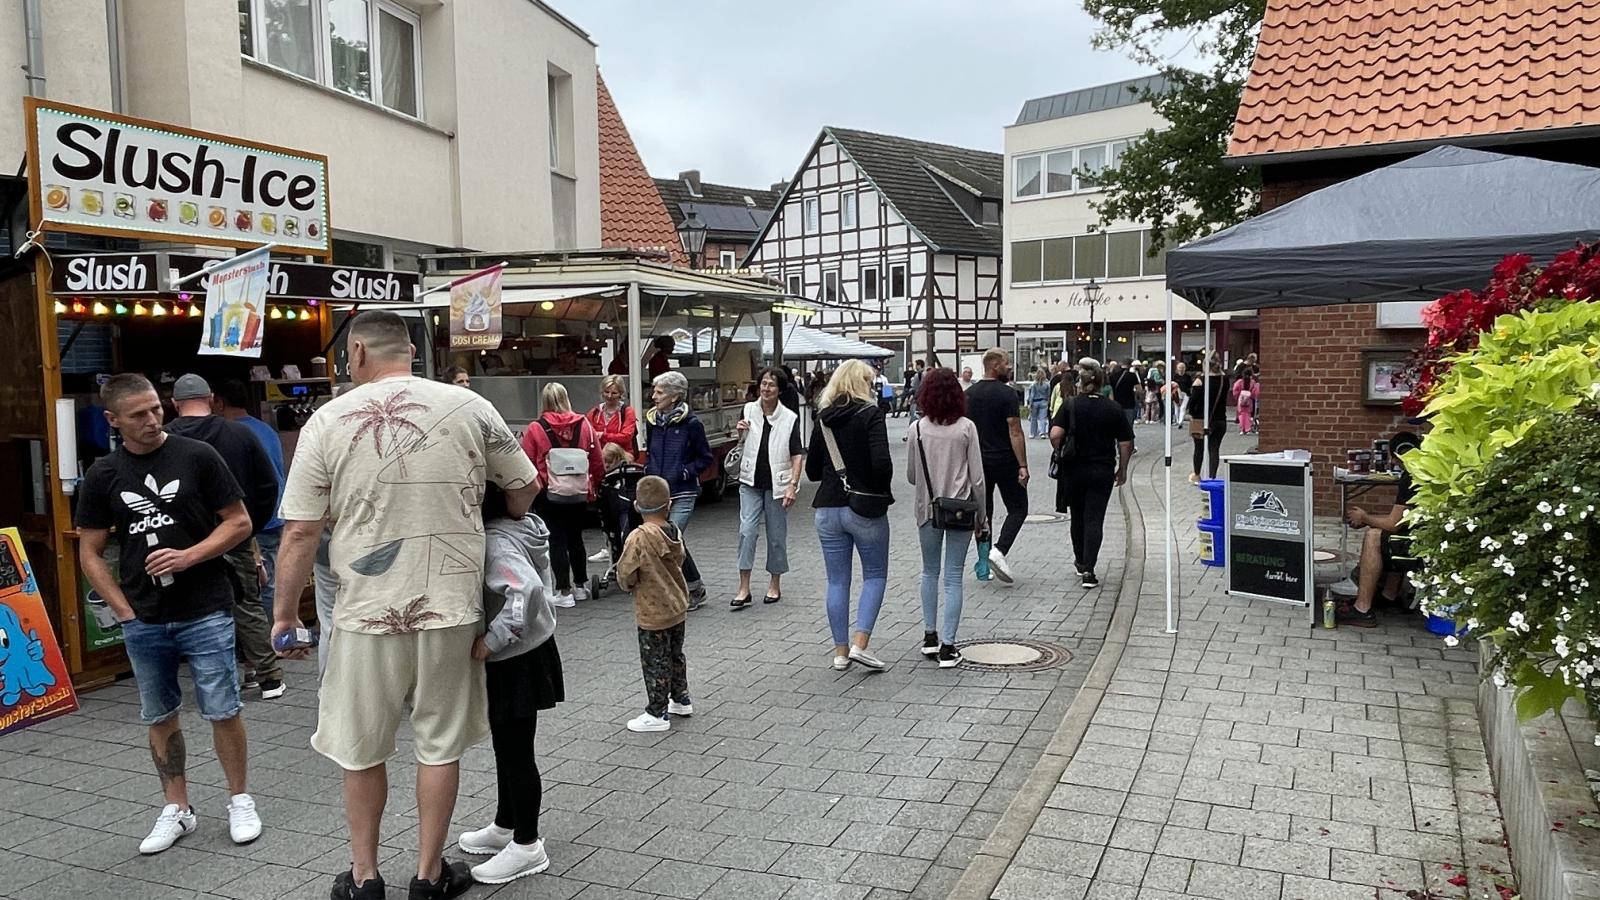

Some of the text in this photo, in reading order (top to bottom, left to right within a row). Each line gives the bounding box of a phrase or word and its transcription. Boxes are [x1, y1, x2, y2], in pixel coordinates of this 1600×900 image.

[52, 122, 316, 211] Slush-Ice
[66, 256, 147, 291] Slush
[330, 269, 400, 300] Slush
[452, 334, 500, 346] COSI CREMA
[129, 512, 175, 535] adida
[1235, 552, 1286, 567] BERATUNG
